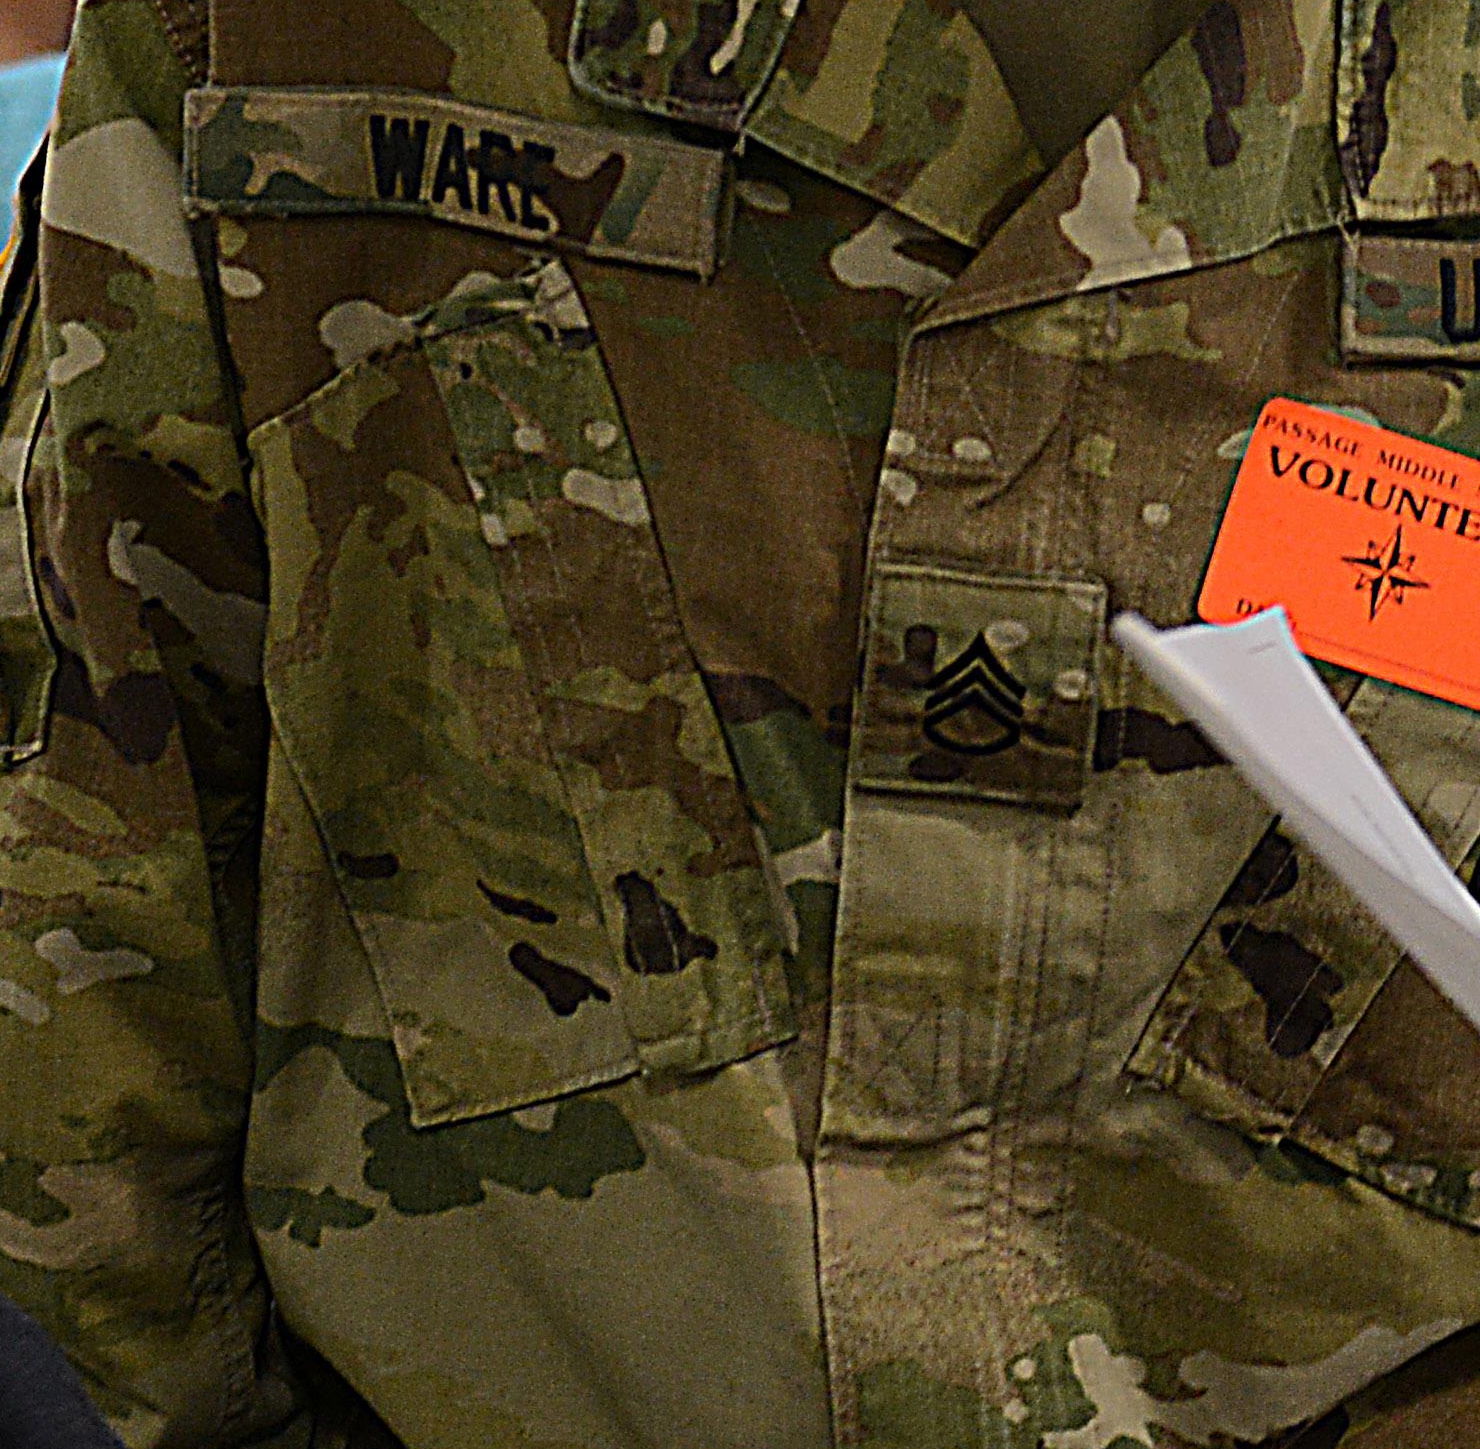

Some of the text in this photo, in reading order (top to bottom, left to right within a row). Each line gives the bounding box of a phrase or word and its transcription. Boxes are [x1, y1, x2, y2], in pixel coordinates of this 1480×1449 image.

[369, 114, 555, 232] WARE
[1262, 413, 1364, 458] PASSAGE
[1376, 448, 1461, 491] MIDDLE
